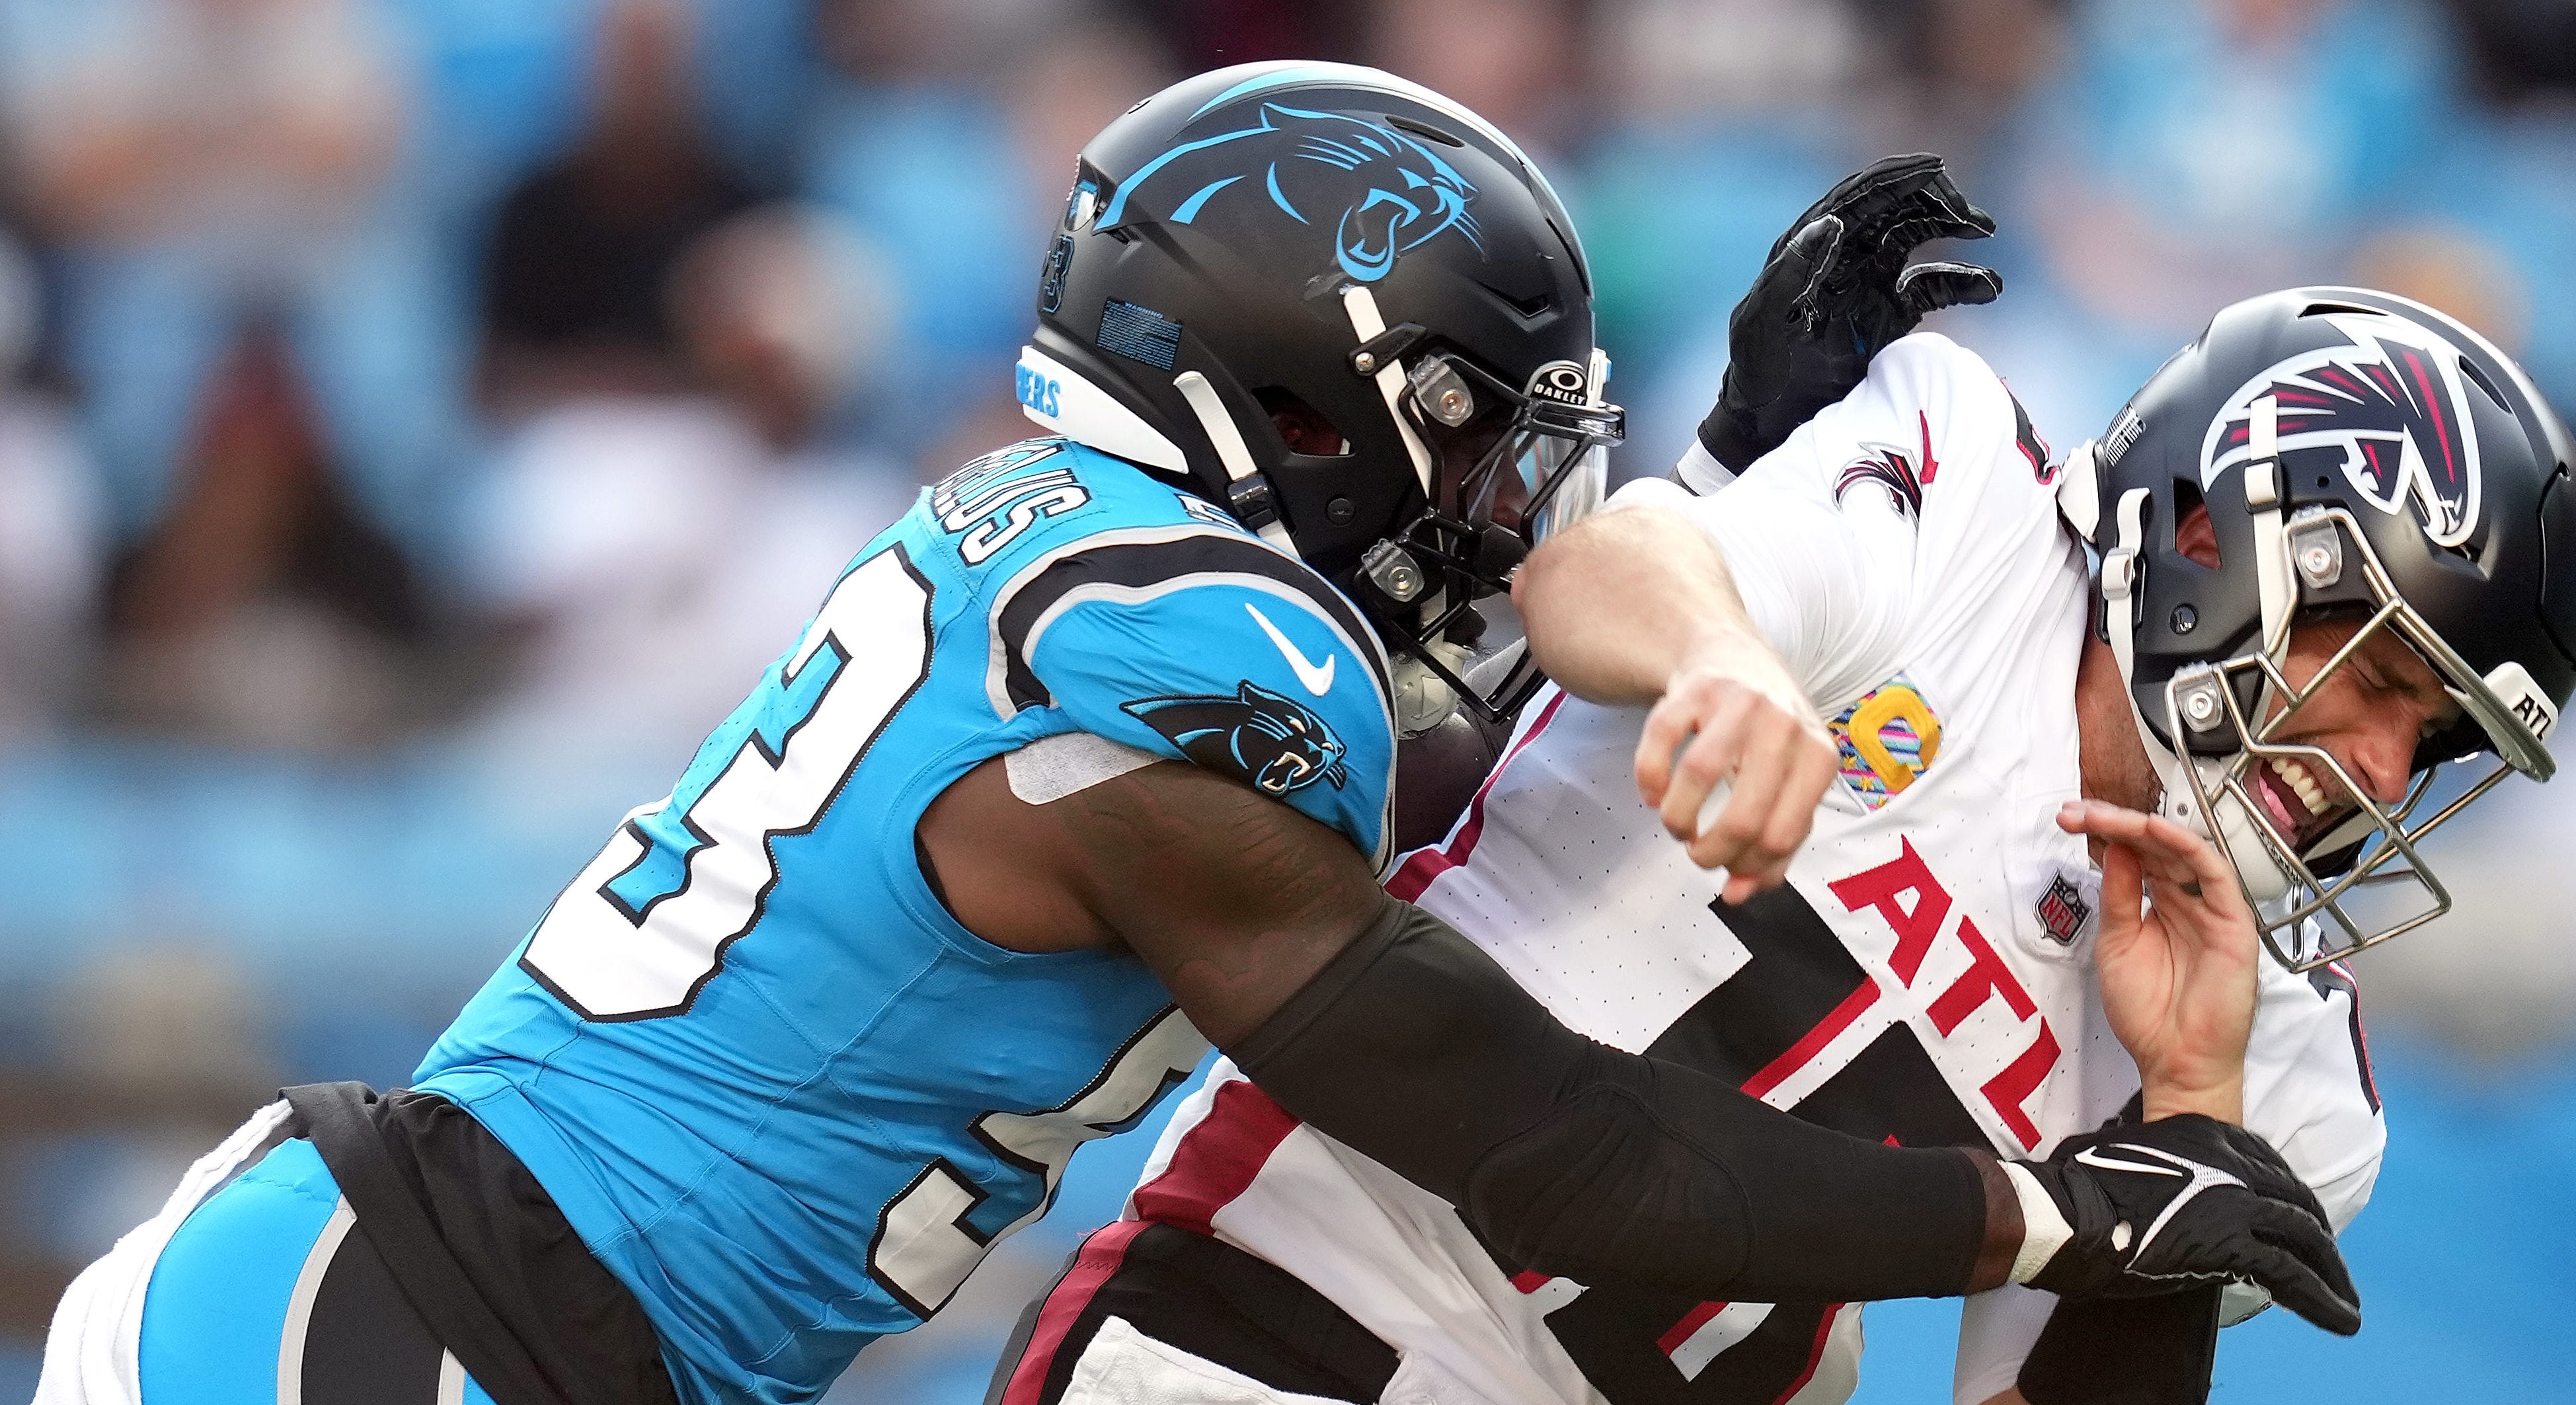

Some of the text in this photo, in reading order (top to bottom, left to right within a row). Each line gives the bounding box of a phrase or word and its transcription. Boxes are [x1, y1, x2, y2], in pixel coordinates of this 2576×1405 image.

[1534, 383, 1586, 405] OAKLEY
[1849, 685, 1941, 792] C
[2041, 892, 2074, 936] NFL
[1828, 834, 2062, 1153] ATL
